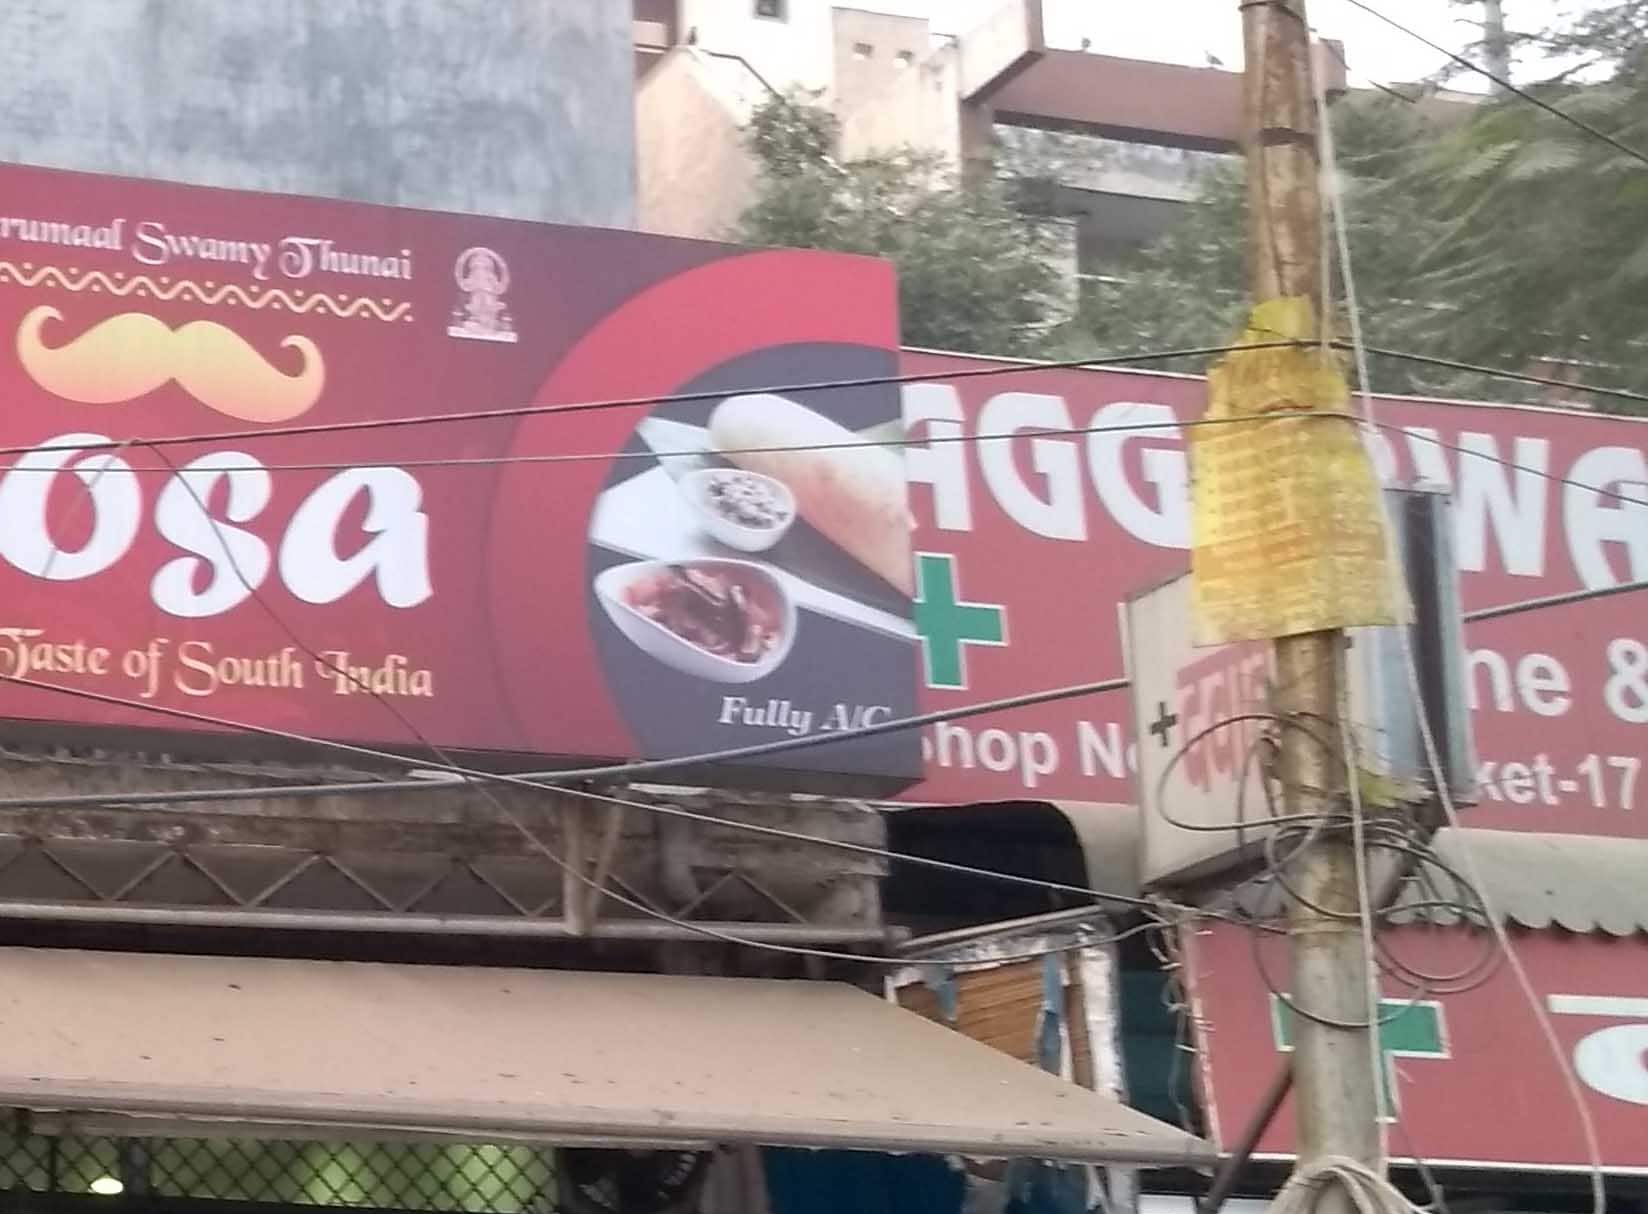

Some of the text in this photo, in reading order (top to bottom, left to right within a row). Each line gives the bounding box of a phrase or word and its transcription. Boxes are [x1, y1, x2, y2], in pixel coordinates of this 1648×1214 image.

[132, 221, 271, 280] Swamy
[278, 236, 414, 280] Thunai
[901, 383, 1648, 593] AGGWA
[122, 638, 171, 698] of
[174, 641, 304, 696] South
[314, 650, 434, 697] India
[1464, 649, 1572, 717] ne
[717, 696, 814, 736] Fully
[921, 720, 1059, 788] hop
[1475, 753, 1641, 809] ket-17
